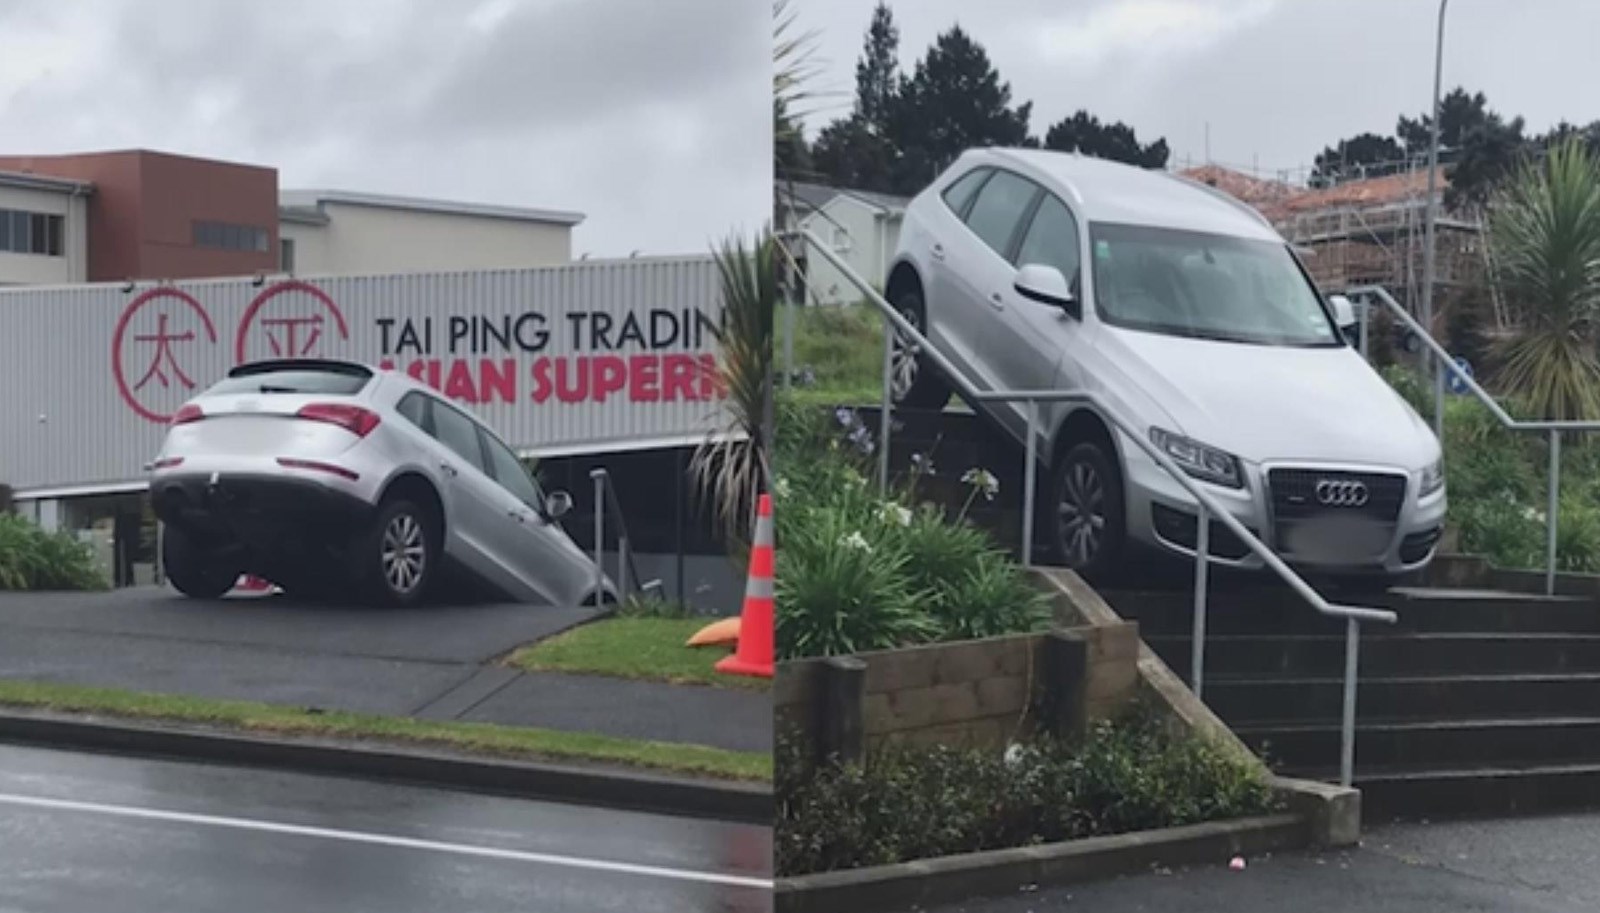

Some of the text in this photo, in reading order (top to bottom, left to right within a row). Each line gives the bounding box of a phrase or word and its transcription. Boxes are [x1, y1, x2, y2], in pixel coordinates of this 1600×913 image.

[376, 315, 431, 354] TAI
[450, 311, 550, 353] PING
[380, 358, 516, 404] IAN
